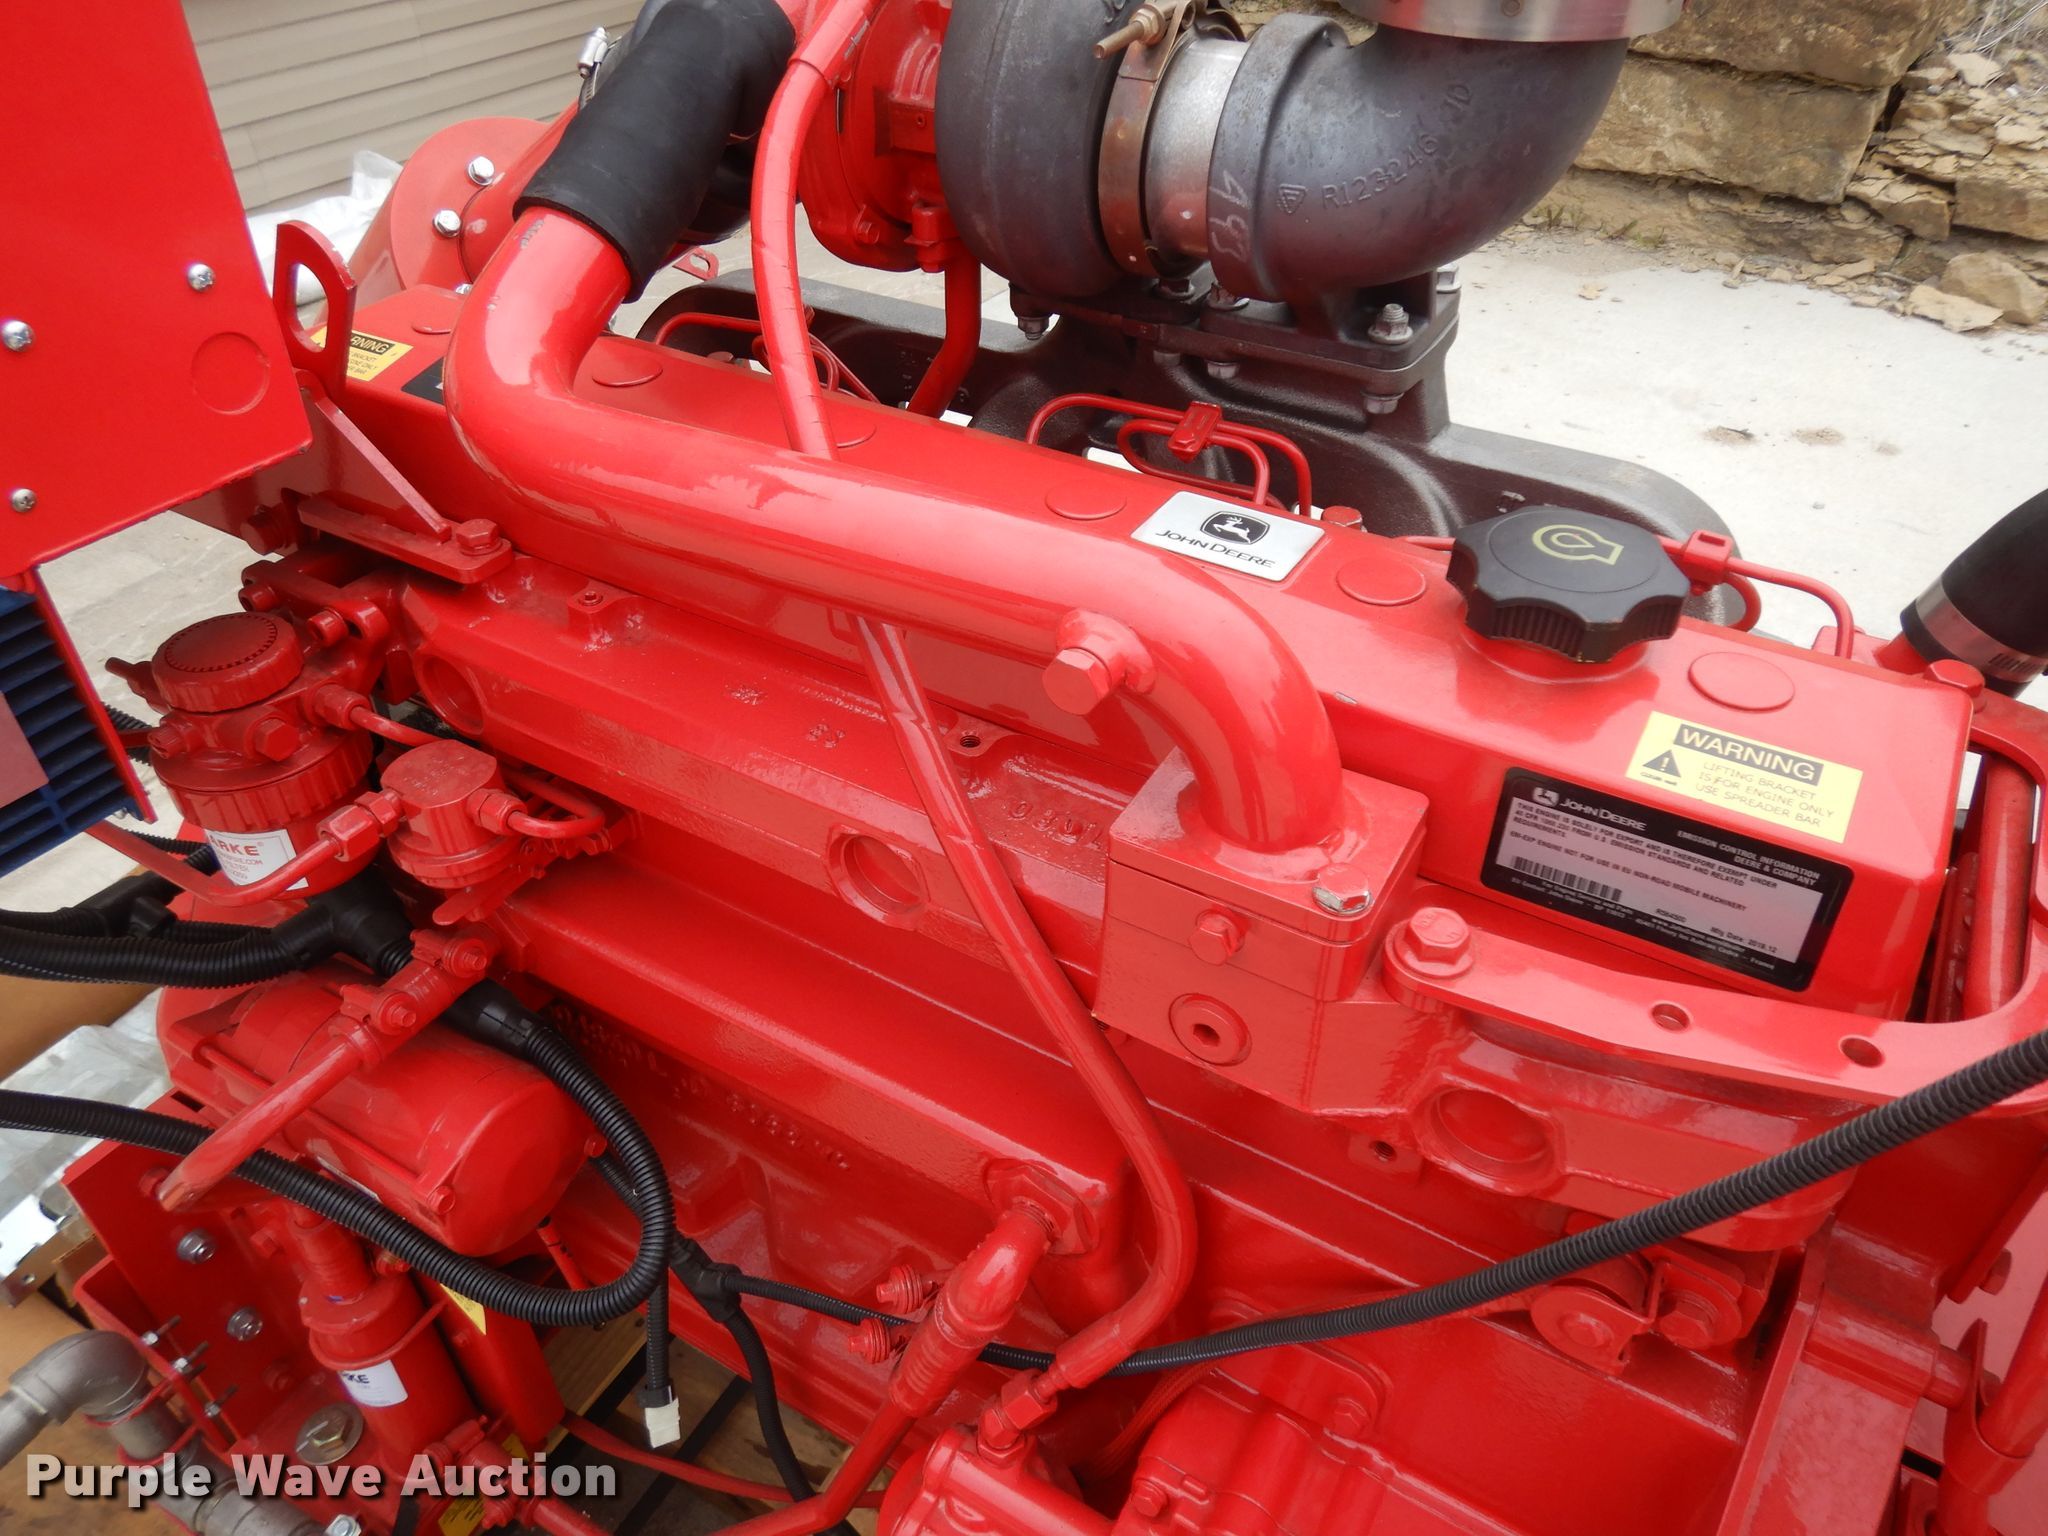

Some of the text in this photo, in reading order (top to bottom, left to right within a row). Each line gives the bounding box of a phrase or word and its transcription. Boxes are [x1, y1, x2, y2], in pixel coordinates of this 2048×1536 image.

[1321, 133, 1440, 211] R123246
[350, 336, 389, 353] RNING
[1155, 529, 1276, 569] JOHN DEERE
[1681, 728, 1816, 781] WARNING
[1702, 761, 1754, 782] LIFTING
[1757, 777, 1816, 801] BRACKET
[1713, 776, 1739, 790] FOR
[1745, 785, 1793, 806] ENGINE
[1798, 801, 1834, 819] ONLY
[1559, 798, 1647, 831] JOHN DEERE
[1694, 782, 1822, 828] USE SPREADER BAR
[1717, 842, 1757, 860] CONTROL
[1759, 855, 1821, 879] INFORMATION
[1734, 856, 1760, 869] DEERE
[1771, 867, 1817, 886] COMPANY
